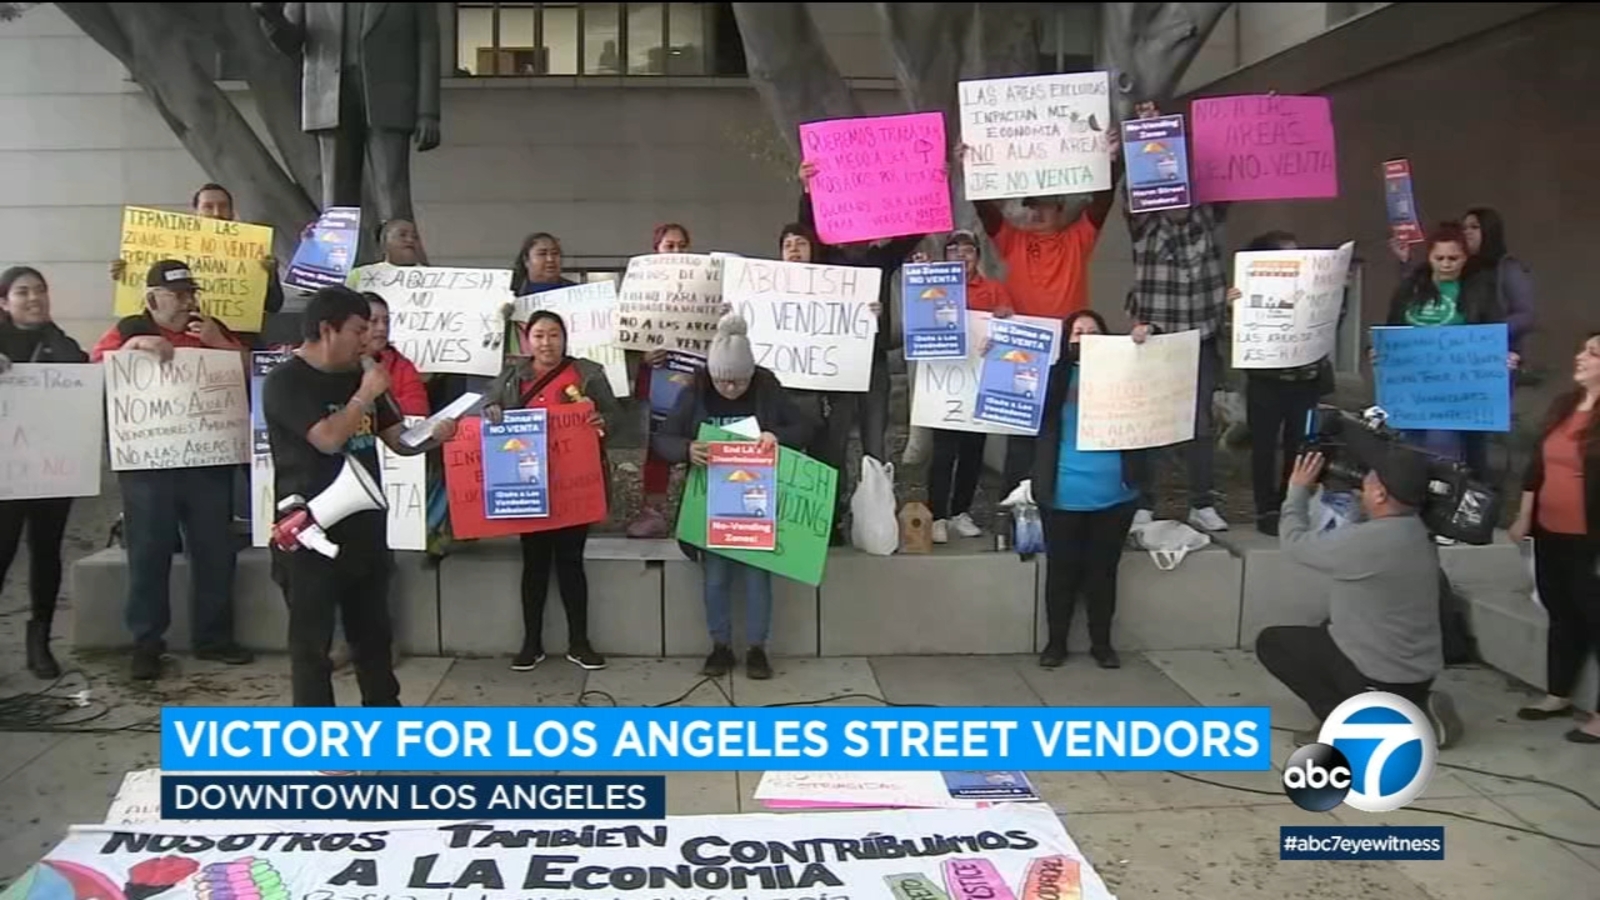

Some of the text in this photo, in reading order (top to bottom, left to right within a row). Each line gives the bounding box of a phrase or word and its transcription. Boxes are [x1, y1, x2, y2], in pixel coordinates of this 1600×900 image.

[964, 84, 998, 107] LAS
[1048, 104, 1070, 118] MI
[986, 122, 1061, 139] ECONOMIA
[970, 143, 994, 163] NO
[1006, 170, 1029, 191] NO
[1036, 164, 1095, 190] VENTA
[129, 210, 240, 236] TERMINEN LAS
[224, 240, 267, 260] VENTA
[237, 261, 247, 274] A
[679, 269, 694, 280] DE
[739, 262, 858, 297] ABOLISH
[909, 274, 959, 284] NO VENTA
[407, 291, 435, 309] NO
[387, 311, 467, 332] NDING
[620, 316, 638, 328] NO
[641, 318, 652, 331] A
[686, 321, 719, 332] AREA
[772, 301, 870, 339] VENDING
[619, 329, 712, 351] DE NO VENT
[994, 332, 1046, 351] NO VENTA
[402, 338, 472, 369] ONES
[753, 342, 839, 378] ZONES
[111, 352, 154, 391] NO
[160, 361, 194, 386] MAS
[924, 361, 966, 397] NO
[114, 394, 187, 426] NO MAS
[490, 424, 540, 434] NO VENTA
[116, 444, 140, 466] NO
[100, 830, 389, 854] NOSOTROS
[438, 824, 669, 848] TAMBIEN
[327, 853, 845, 890] A LA ECONOMIA
